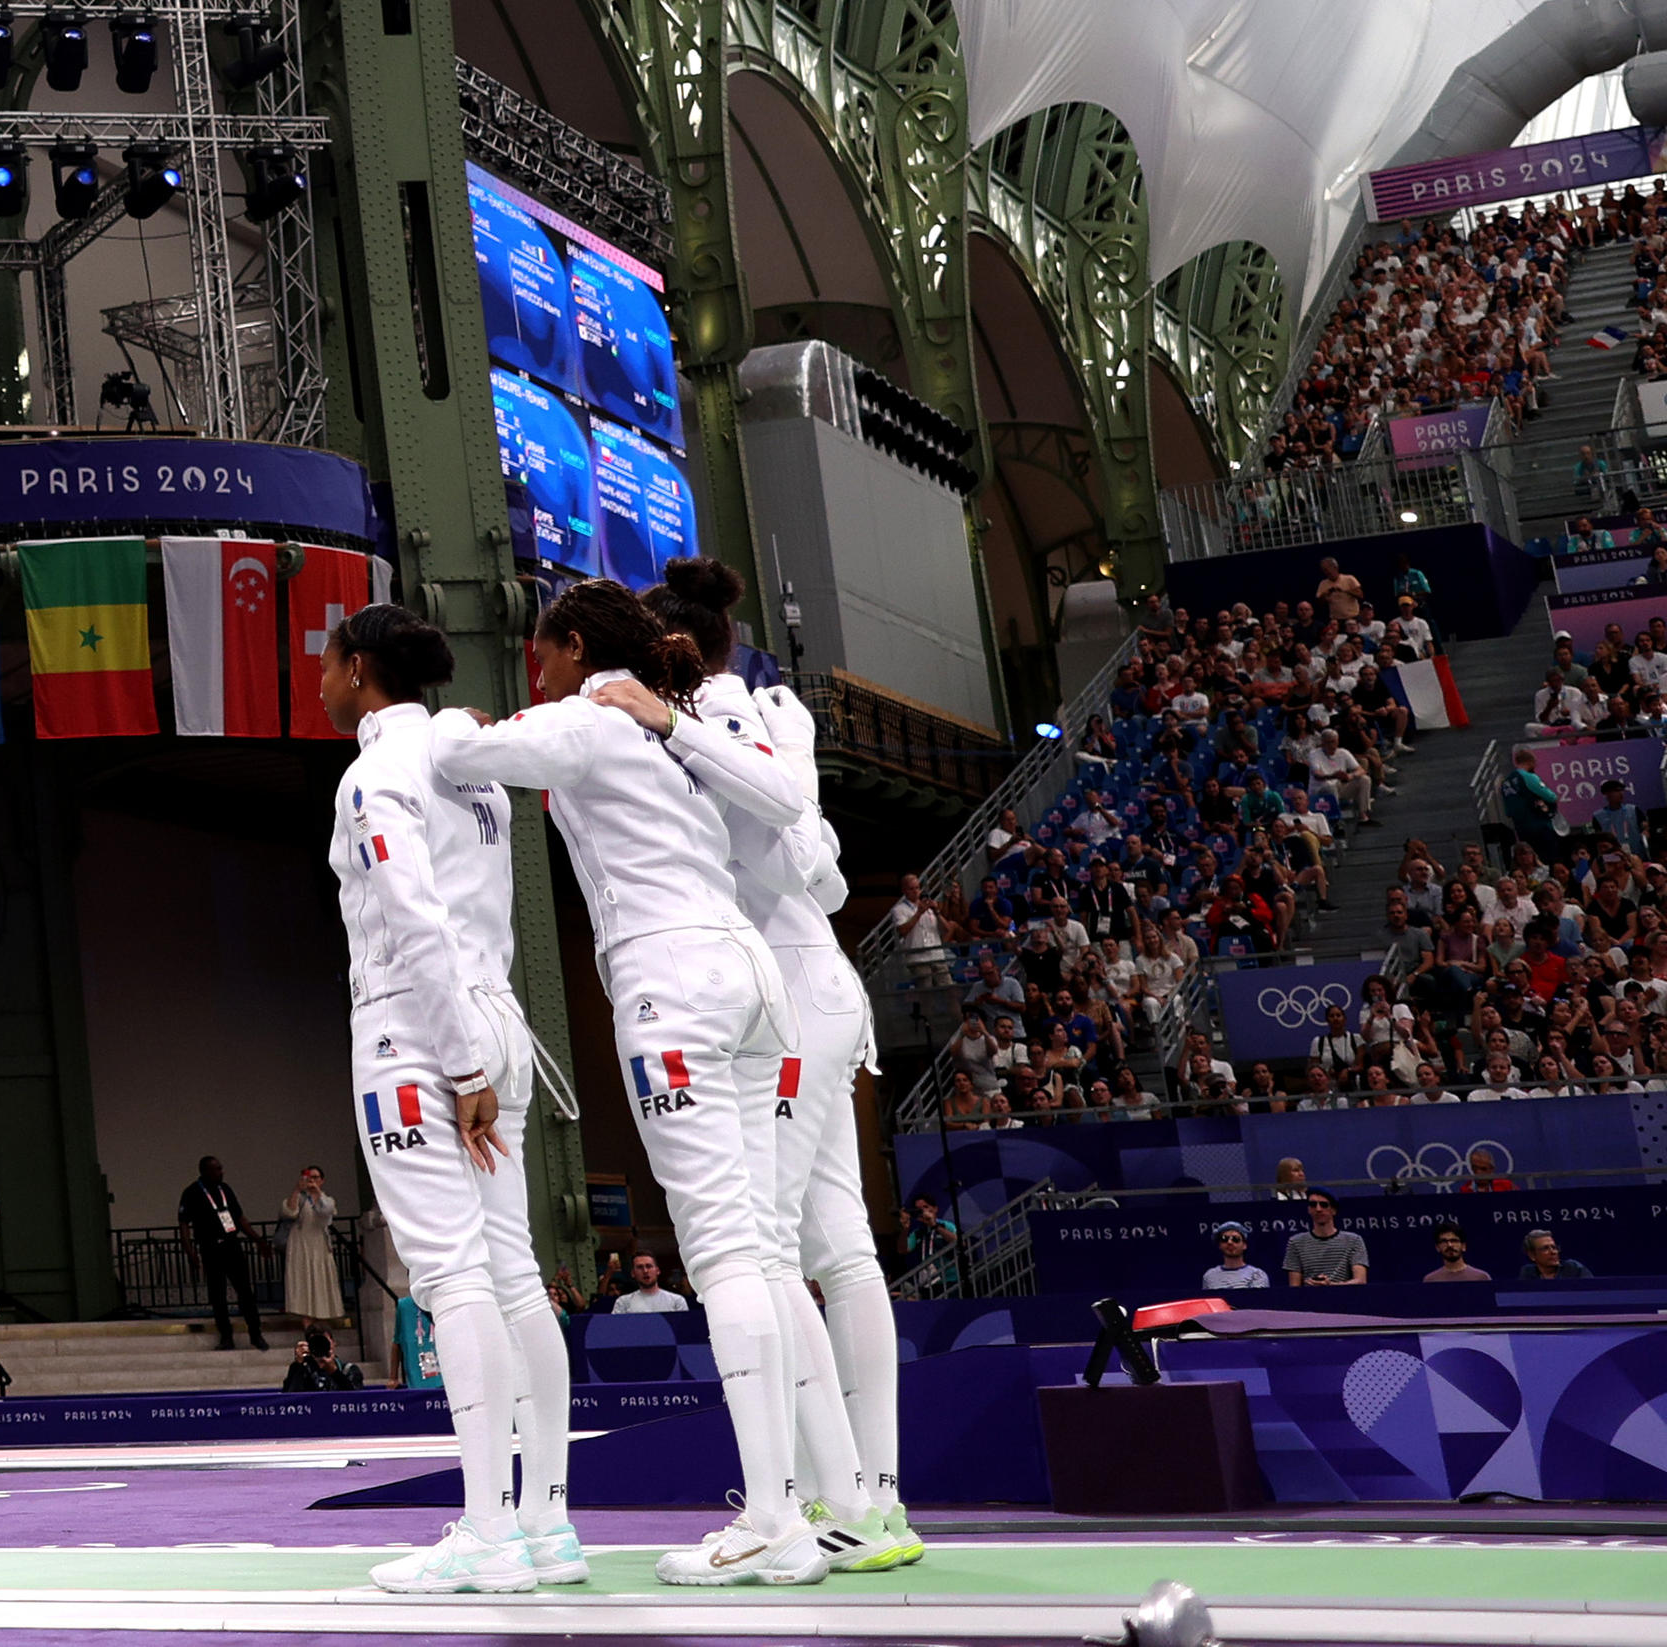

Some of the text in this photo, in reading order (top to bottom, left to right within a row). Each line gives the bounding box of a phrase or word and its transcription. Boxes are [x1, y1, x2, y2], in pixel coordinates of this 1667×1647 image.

[1519, 151, 1608, 183] 2024
[1414, 420, 1468, 439] PARIS
[21, 466, 254, 495] PARIS 2024
[1551, 756, 1630, 780] PARIS
[639, 1089, 697, 1120] FRA
[369, 1127, 428, 1156] FRA
[1561, 1207, 1615, 1221] 2024
[1260, 1219, 1309, 1232] 2024
[1120, 1226, 1168, 1239] 2024
[371, 1402, 405, 1412] 2024
[426, 1400, 450, 1410] PAR
[572, 1398, 598, 1408] 024
[663, 1395, 699, 1406] 2024
[101, 1410, 131, 1420] 2024
[189, 1408, 220, 1417] 2024
[279, 1405, 311, 1415] 2024
[16, 1412, 45, 1422] 2024
[878, 1473, 898, 1489] FR
[549, 1483, 567, 1501] FR
